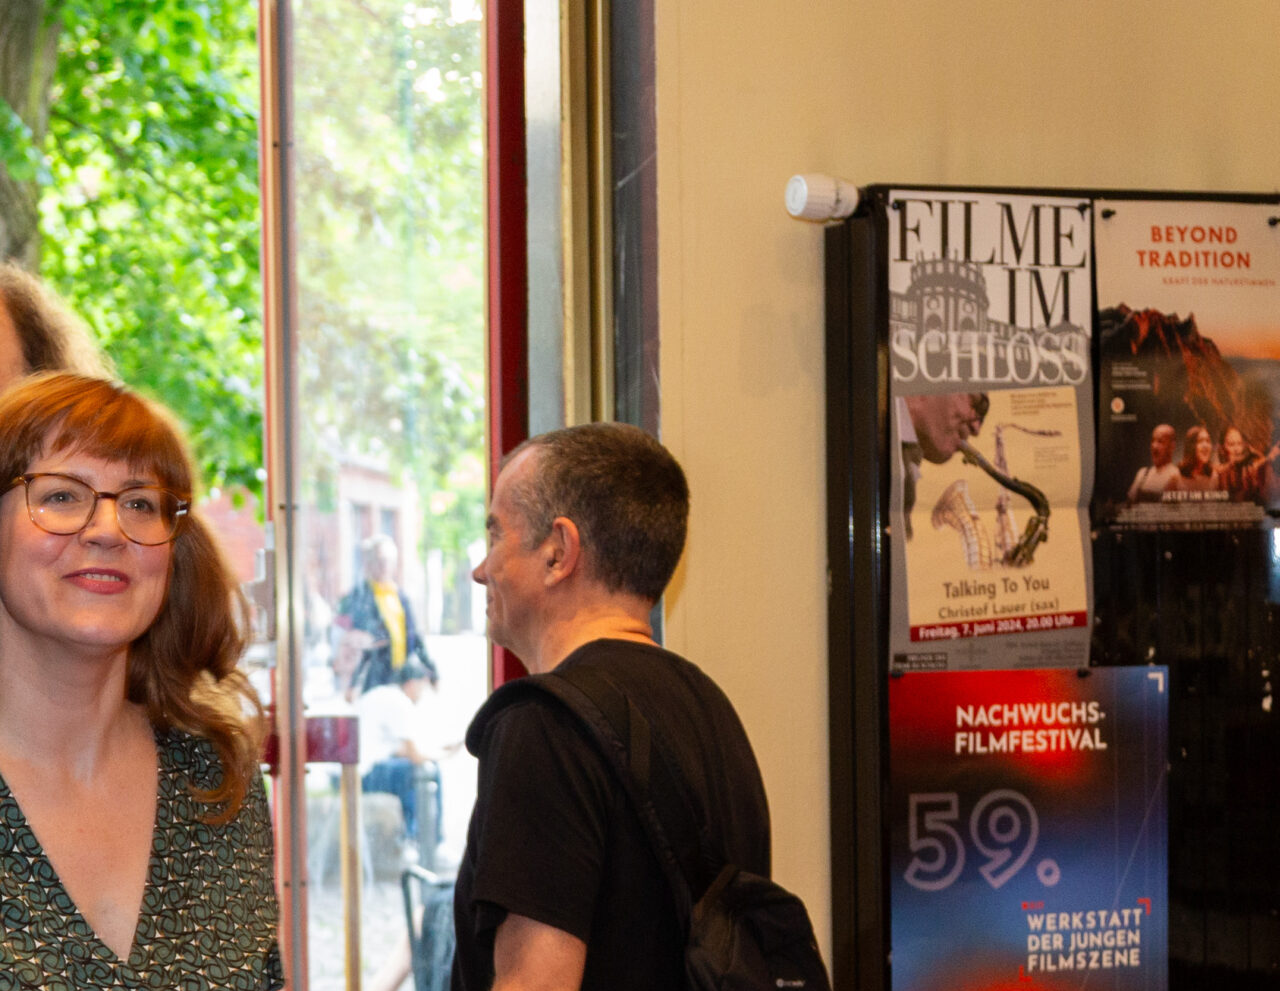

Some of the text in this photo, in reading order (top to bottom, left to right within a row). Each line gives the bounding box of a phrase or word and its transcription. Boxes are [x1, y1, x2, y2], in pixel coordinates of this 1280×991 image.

[893, 198, 1087, 269] FILME
[1150, 226, 1238, 244] BEYOND
[1136, 250, 1251, 269] TRADITION
[1002, 266, 1075, 333] IM
[891, 328, 1089, 384] SCHLOSS
[943, 575, 1050, 599] Talking To You
[938, 599, 1060, 620] Christof Lauer (sax)
[919, 615, 1075, 640] Freitag, 7. Juni 2024, 20.00 Uhr
[956, 702, 1106, 728] NACHWUCHS-
[955, 728, 1107, 754] FILMFESTIVAL
[904, 789, 1061, 891] 59.
[1027, 908, 1142, 931] WERKSTATT
[1027, 929, 1141, 952] DER JUNGEN
[1027, 948, 1141, 973] FILMSZENE
